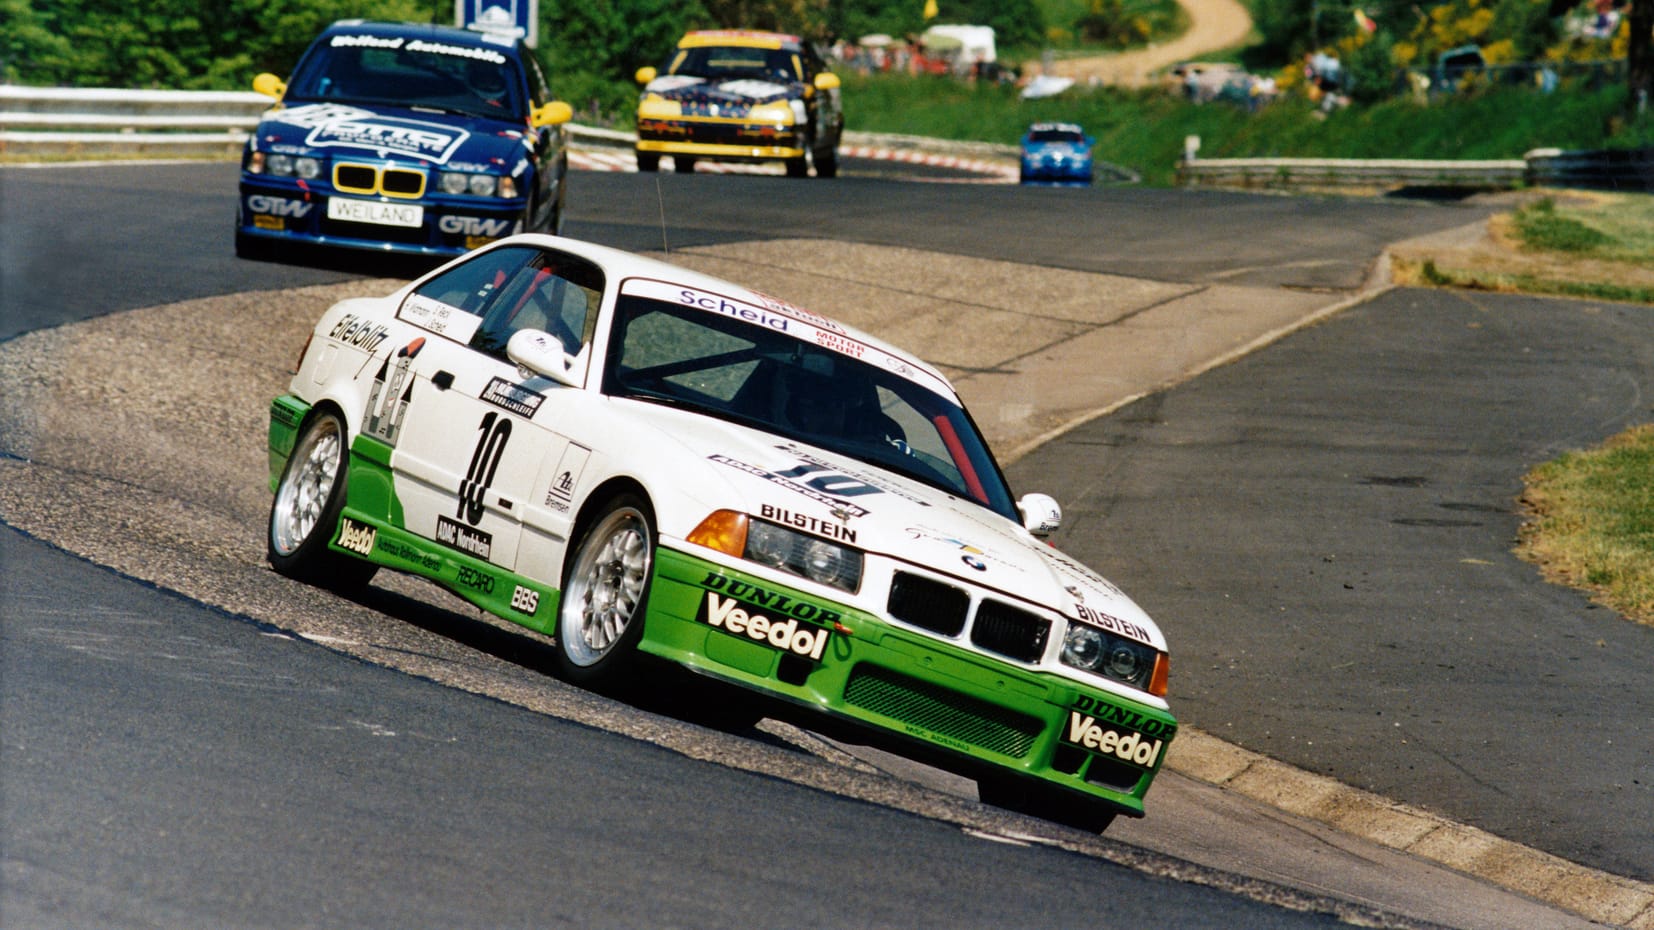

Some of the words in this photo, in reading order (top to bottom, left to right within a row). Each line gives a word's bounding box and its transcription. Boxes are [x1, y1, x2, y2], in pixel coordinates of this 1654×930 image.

[336, 203, 416, 224] WEILAND
[680, 290, 788, 331] Scheid
[816, 331, 865, 353] MOTOR
[817, 337, 862, 358] SPORT
[456, 411, 513, 526] 10
[773, 458, 887, 497] 10
[337, 519, 376, 556] Veedol
[438, 520, 456, 544] ADAC
[457, 527, 489, 559] Nordrhein
[761, 504, 857, 543] BILSTEIN
[457, 566, 495, 594] RECARO
[511, 585, 539, 614] BBS
[700, 572, 842, 625] DUNLOP
[708, 591, 829, 660] Veedol
[1075, 604, 1152, 643] BILSTEIN
[1073, 694, 1177, 738] DUNLOP
[1069, 711, 1162, 768] Veedol
